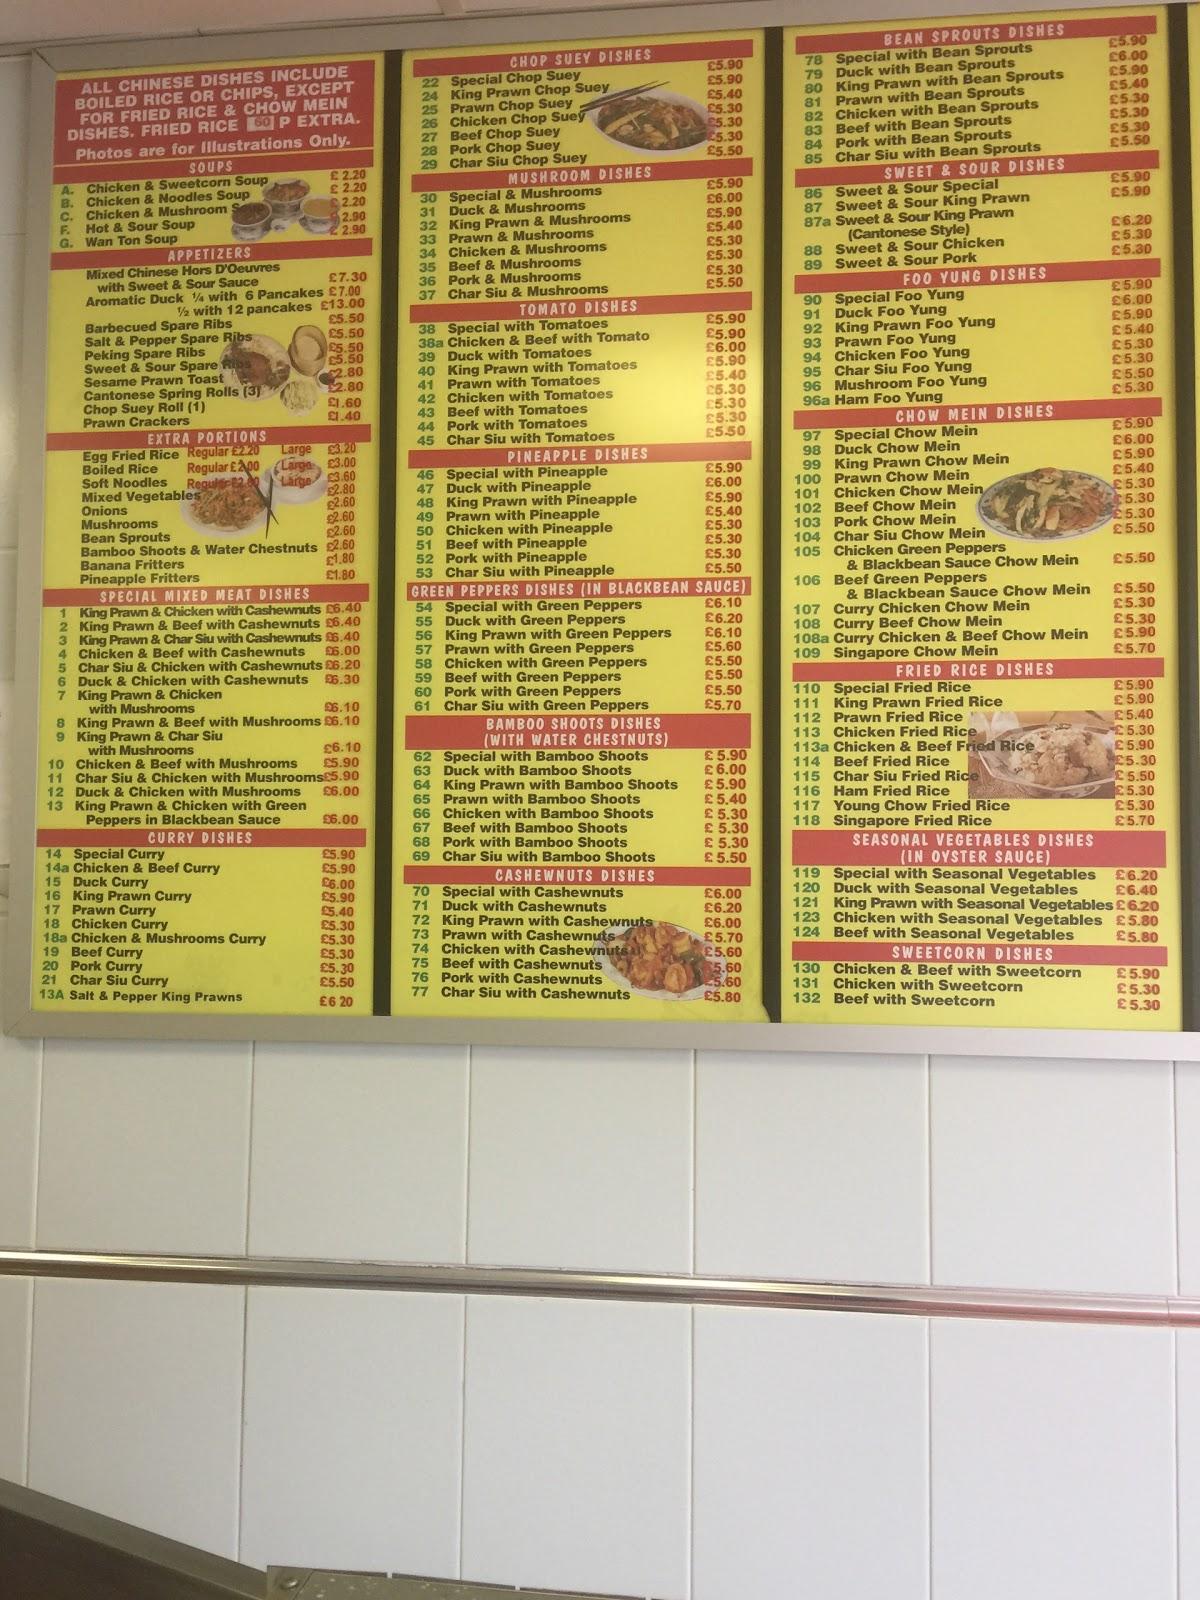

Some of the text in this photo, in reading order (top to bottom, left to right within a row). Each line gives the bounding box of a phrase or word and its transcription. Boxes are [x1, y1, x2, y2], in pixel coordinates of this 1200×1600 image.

[884, 23, 1064, 46] BEAN SPROUTS DISHES
[510, 48, 651, 68] CHOP SUEY DISHES
[708, 59, 743, 71] £5.90
[82, 66, 348, 95] ALL CHINESE DISHES INCLUDE
[422, 69, 581, 88] 22 Special Chop Suey
[75, 81, 354, 110] BOILED RICE OR CHIPS, EXCEPT
[804, 85, 1025, 108] 81 Prawn with Bean Sprouts
[80, 97, 347, 125] FOR FRIED RICE & CHOW MEIN
[68, 126, 134, 141] DISHES.
[142, 122, 191, 137] FRIED
[198, 119, 238, 133] RICE
[280, 116, 291, 128] P
[297, 112, 360, 127] EXTRA.
[76, 133, 350, 160] Photos are for Illustrations Only.
[189, 161, 232, 174] SOUPS
[509, 166, 651, 184] MUSHROOM DISHES
[885, 158, 1064, 179] SWEET & SOUR DISHES
[61, 174, 268, 195] A. Chicken & Sweetcorn Soup
[848, 223, 970, 240] (Cantonese Style)
[59, 233, 178, 249] G. Wan Ton Soup
[168, 247, 251, 261] APPETIZERS
[904, 267, 1046, 286] FOO YUNG DISHES
[520, 300, 637, 316] TOMATO DISHES
[419, 347, 592, 362] 39 Duck with Tomatoes
[896, 405, 1053, 423] CHOW MEIN DISHES
[83, 416, 190, 428] Prawn Crackers
[148, 430, 266, 445] EXTRA PORTIONS
[508, 447, 648, 463] PINEAPPLE DISHES
[83, 463, 158, 475] Boiled Rice
[417, 494, 637, 510] 48 King Prawn with Pineapple
[706, 492, 742, 503] £5.90
[82, 519, 158, 530] Mushrooms
[100, 588, 309, 603] SPECIAL MIXED MEAT DISHES
[412, 581, 746, 597] GREEN PEPPERS DISHES (IN BLACKBEAN SAUCE)
[58, 647, 305, 659] 4 Chicken & Beef with Cashewnuts
[326, 645, 360, 656] £6.00
[794, 645, 998, 660] 109 Singapore Chow Mein
[896, 663, 1053, 677] FRIED RICE DISHES
[487, 717, 661, 730] BAMBOO SHOOTS DISHES
[485, 733, 668, 747] (WITH WATER CHESTNUTS)
[413, 808, 653, 819] 66 Chicken with Bamboo Shoots
[148, 832, 252, 844] CURRY DISHES
[853, 833, 1093, 846] SEASONAL VEGETABLES DISHES
[46, 849, 165, 861] 14 Special Curry
[322, 849, 355, 860] £5.90
[901, 850, 1050, 864] (IN OYSTER SAUCE)
[496, 869, 654, 882] CASHEWNUTS DISHES
[892, 946, 1053, 960] SWEETCORN DISHES
[40, 989, 242, 1004] 13A Salt & Pepper King Prawns
[793, 992, 995, 1006] 132 Beef with Sweetcorn
